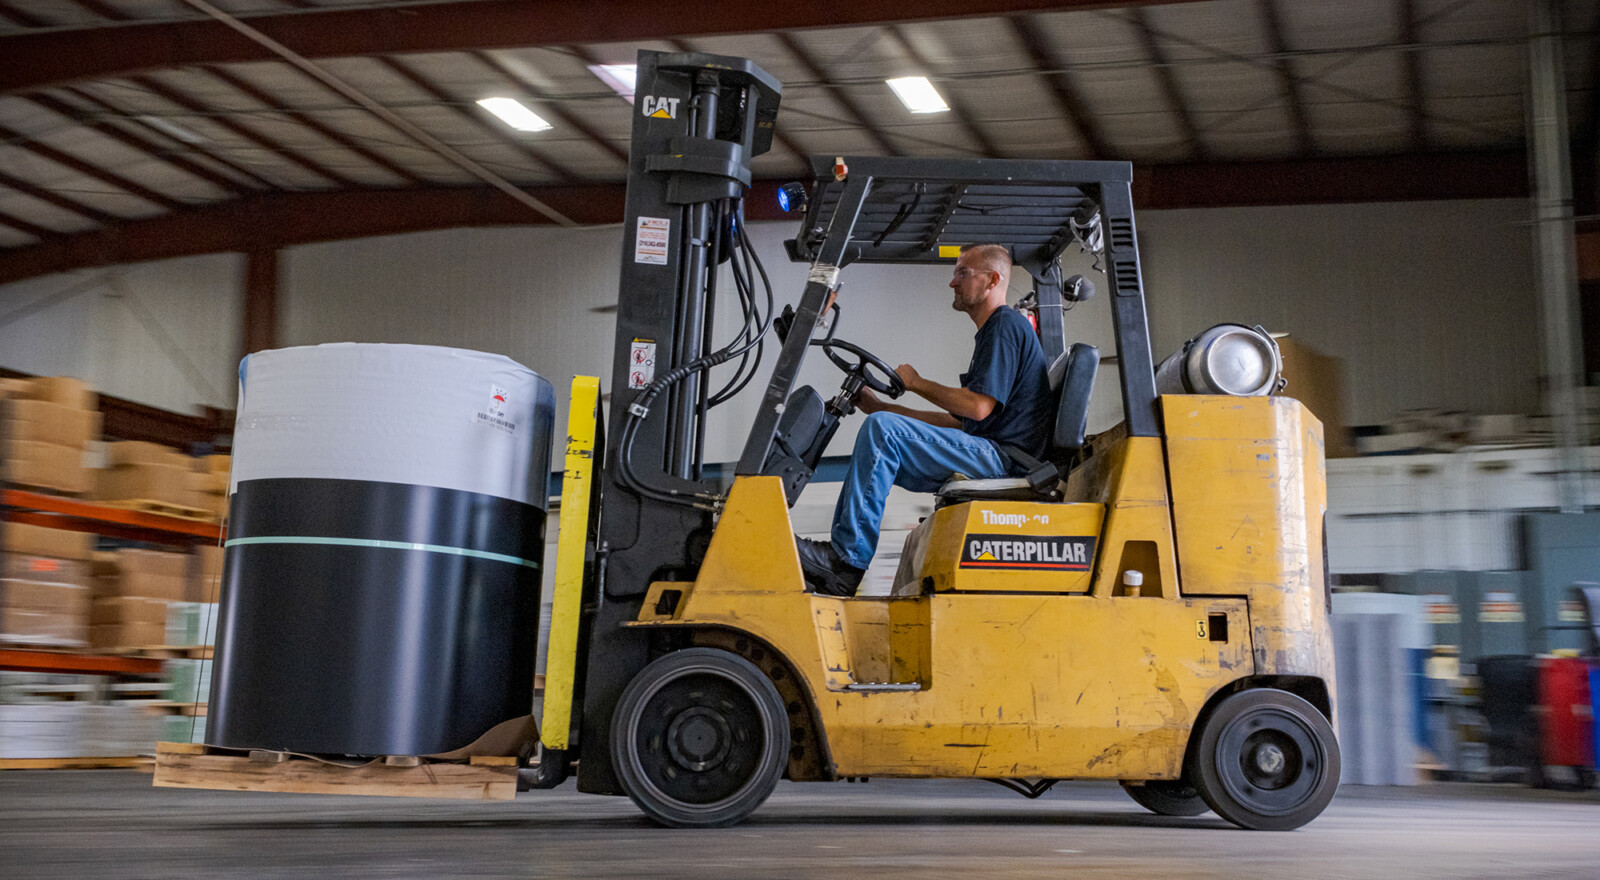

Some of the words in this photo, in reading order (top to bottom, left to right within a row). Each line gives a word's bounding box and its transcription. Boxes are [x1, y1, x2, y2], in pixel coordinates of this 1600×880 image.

[642, 95, 680, 119] CAT
[981, 510, 1049, 528] Thompn
[969, 540, 1086, 562] CATERPILLAR
